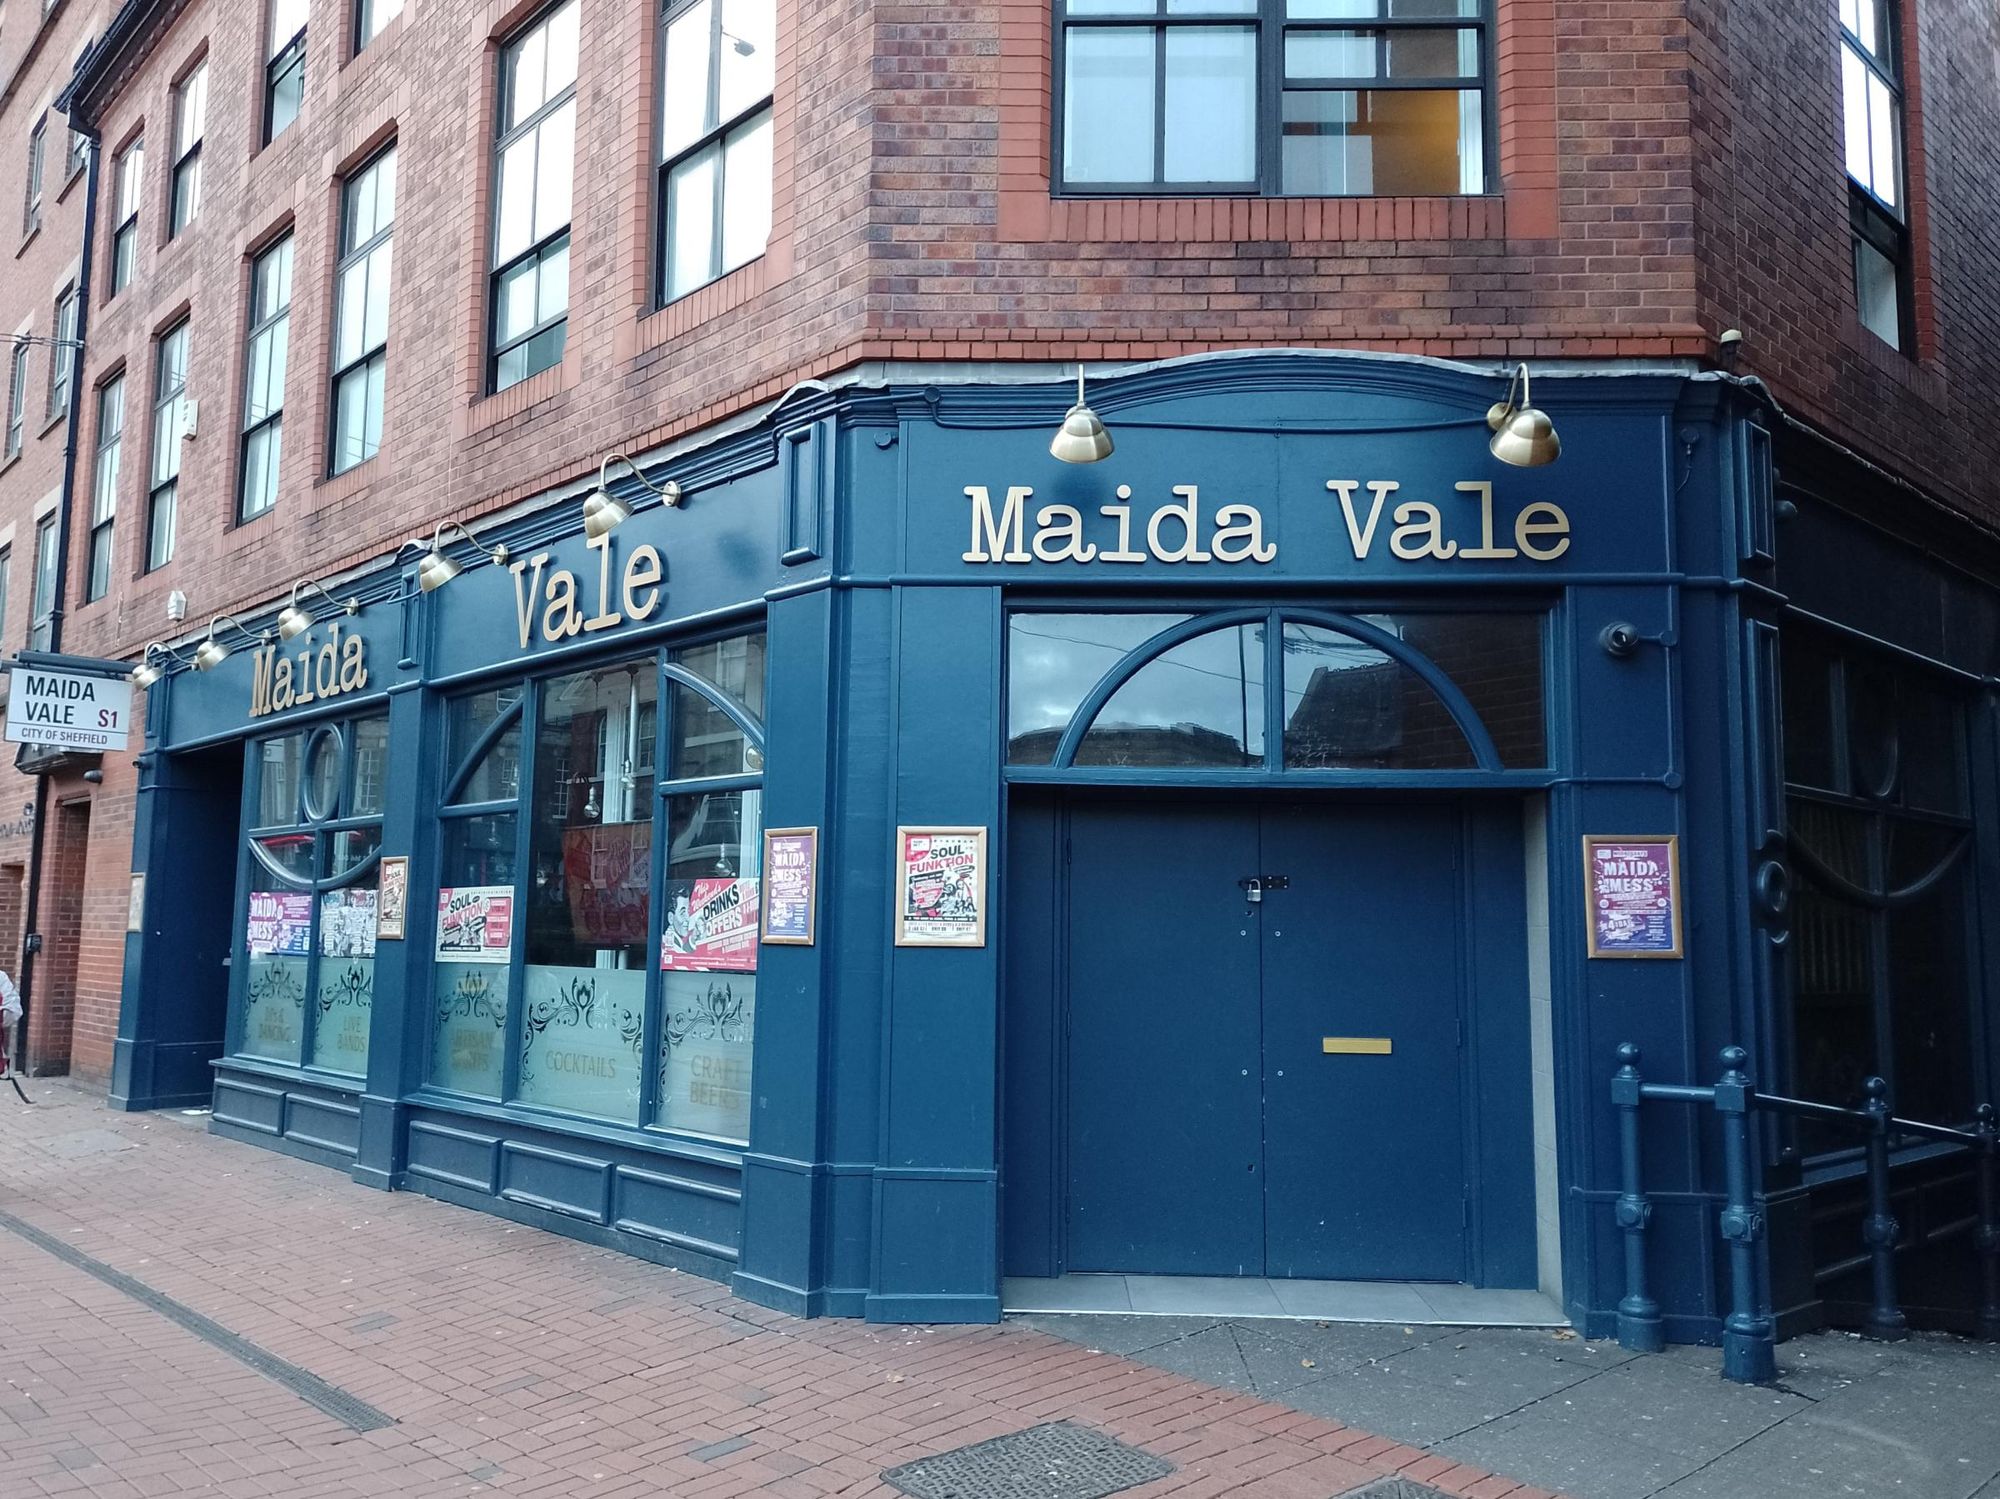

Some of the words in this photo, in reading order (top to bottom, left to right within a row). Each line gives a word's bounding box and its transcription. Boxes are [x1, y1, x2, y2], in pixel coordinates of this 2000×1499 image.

[961, 484, 1278, 563] Maida
[1326, 480, 1572, 561] Vale
[248, 622, 369, 718] Maida
[509, 531, 662, 650] Vale
[25, 675, 96, 702] MAIDA
[25, 700, 75, 725] VALE
[97, 708, 118, 729] S1
[21, 727, 44, 739] CITY
[45, 730, 58, 740] OF
[59, 731, 108, 745] SHEFFIELD
[909, 854, 974, 875] FUNKTION
[930, 844, 965, 860] SOUL
[1603, 860, 1660, 876] MAIDA
[1609, 877, 1655, 893] MESS
[449, 893, 472, 914] SOUL
[703, 883, 740, 921] DRINKS
[705, 906, 743, 936] OFFERS
[545, 1050, 617, 1079] COCKTAILS
[690, 1054, 744, 1082] CRAFT
